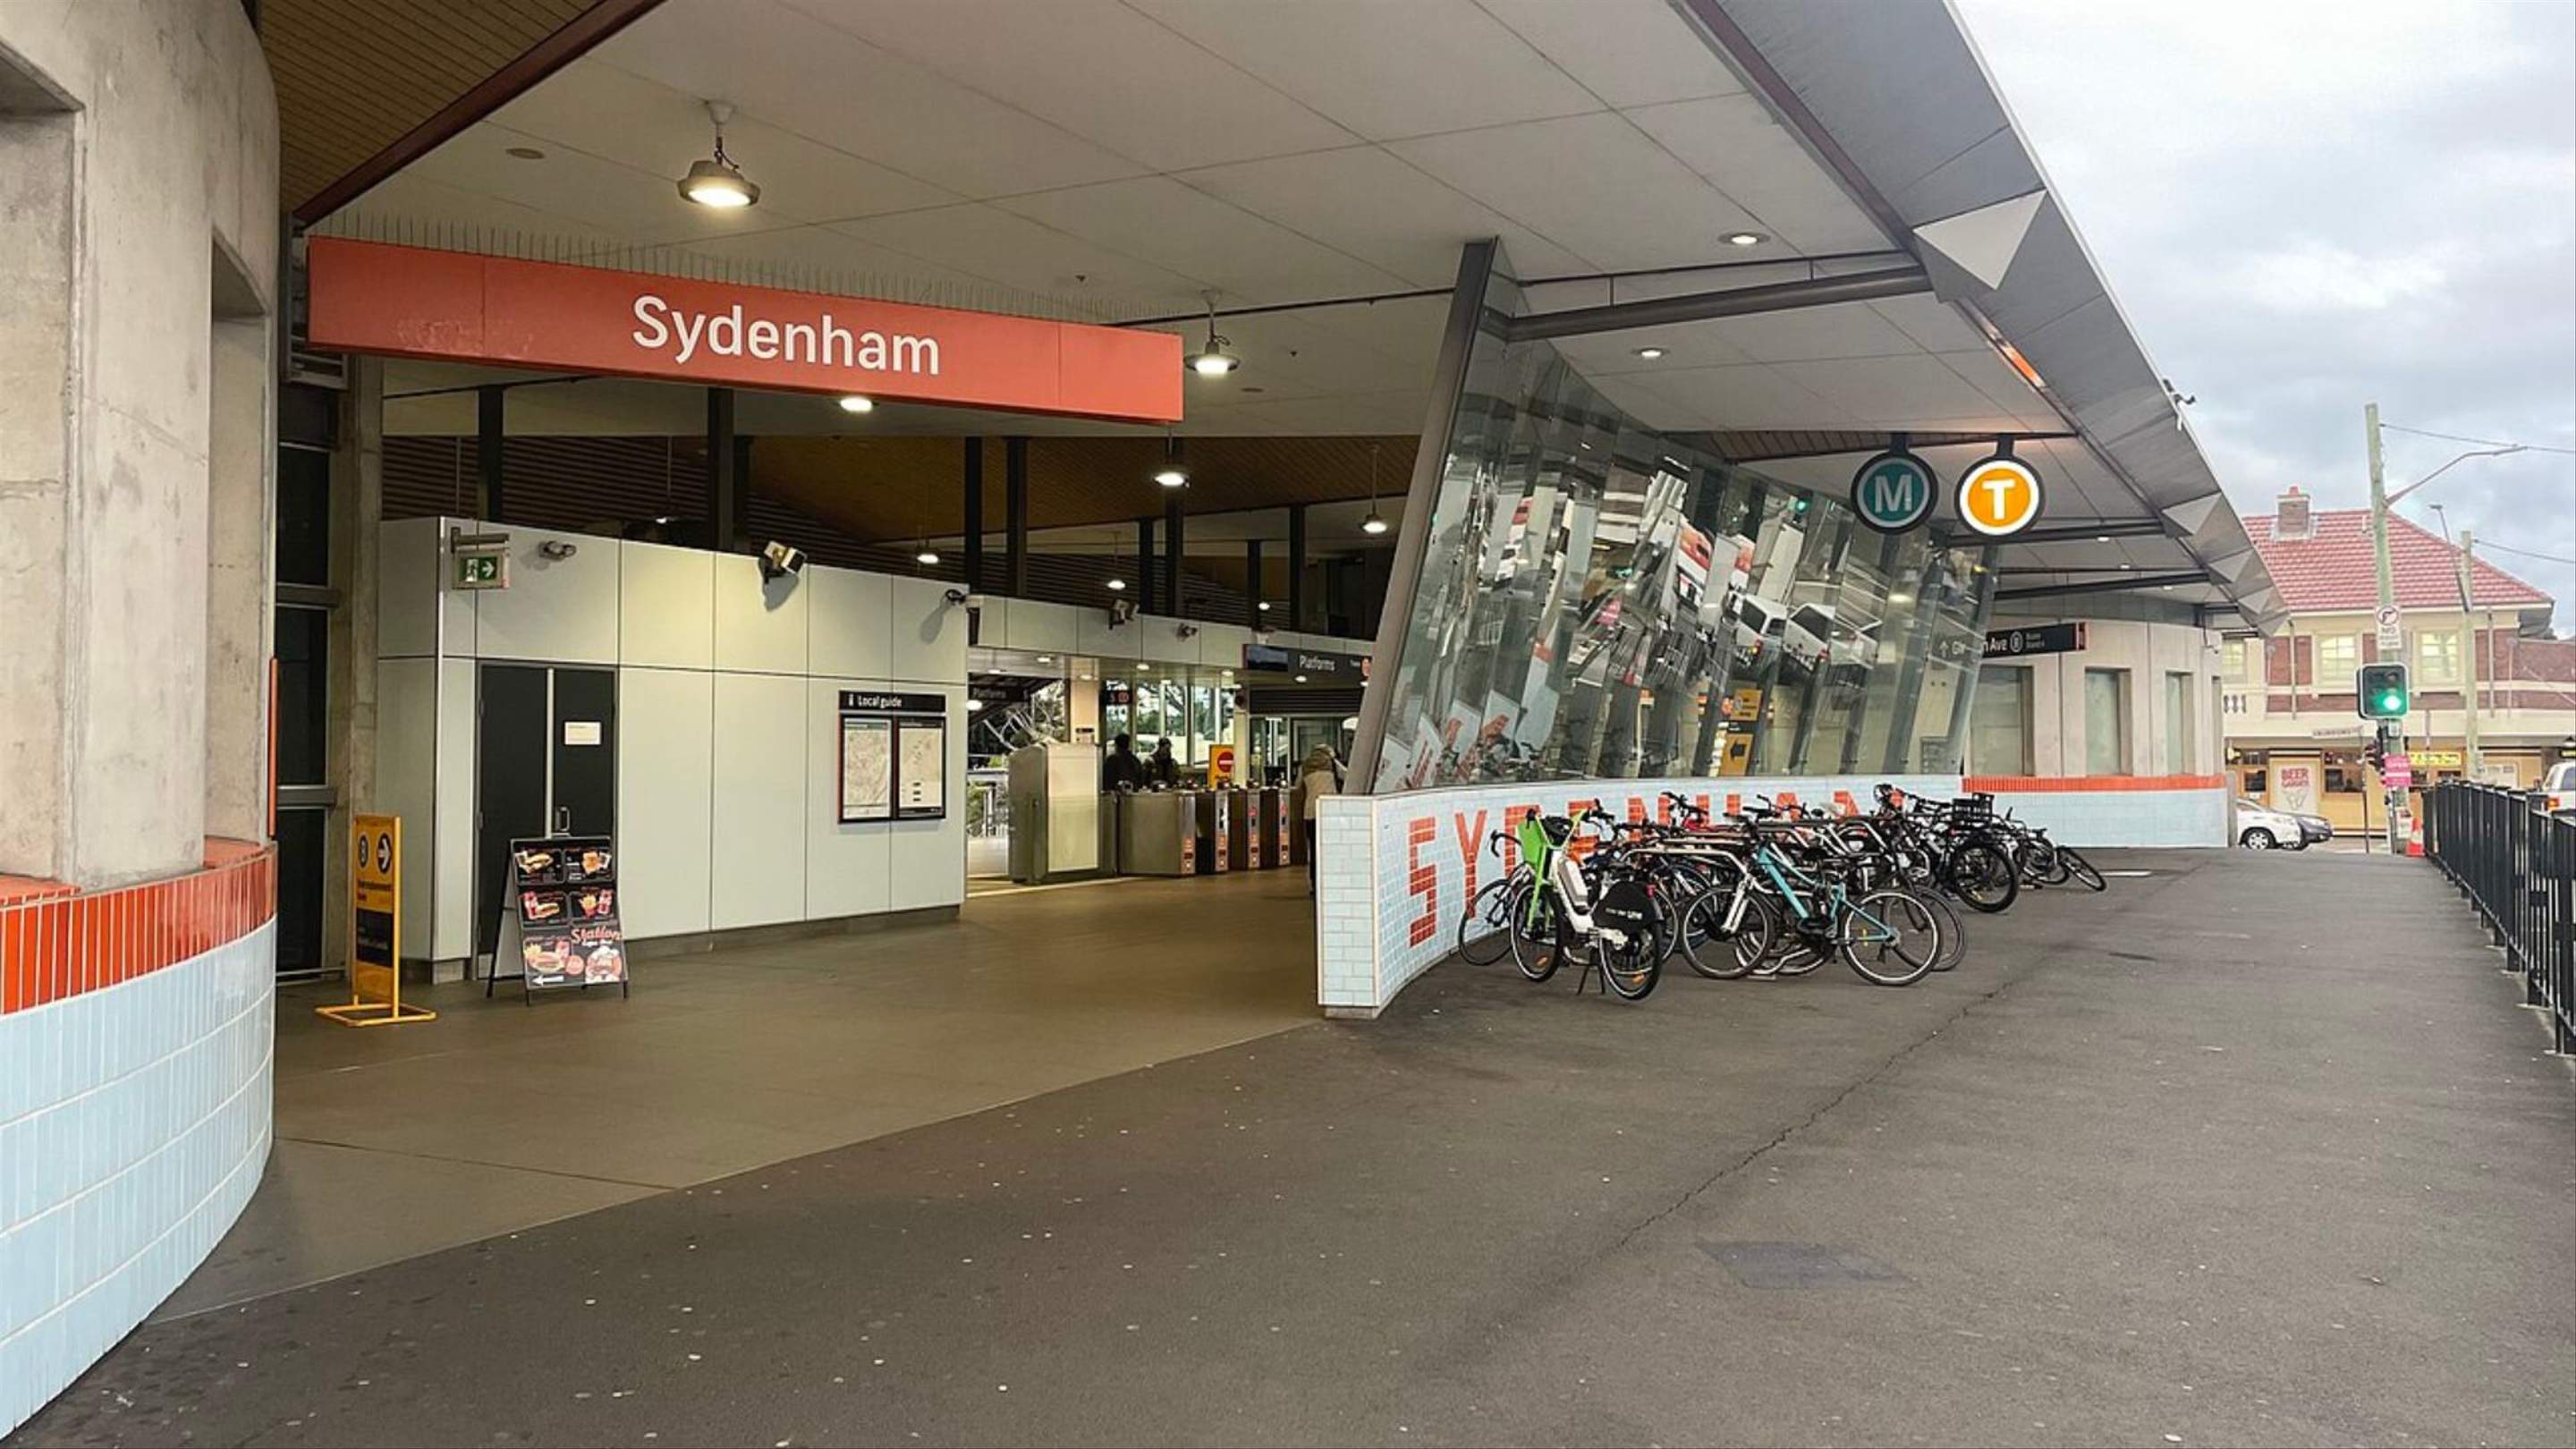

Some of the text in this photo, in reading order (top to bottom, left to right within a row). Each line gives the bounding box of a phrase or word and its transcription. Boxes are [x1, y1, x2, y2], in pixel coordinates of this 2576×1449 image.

[631, 295, 940, 376] Sydenham
[1874, 474, 1912, 513] M
[1981, 479, 2016, 521] T
[1989, 637, 2008, 652] Ave
[858, 695, 880, 708] Local
[880, 696, 902, 709] guide
[2281, 768, 2309, 779] BEER
